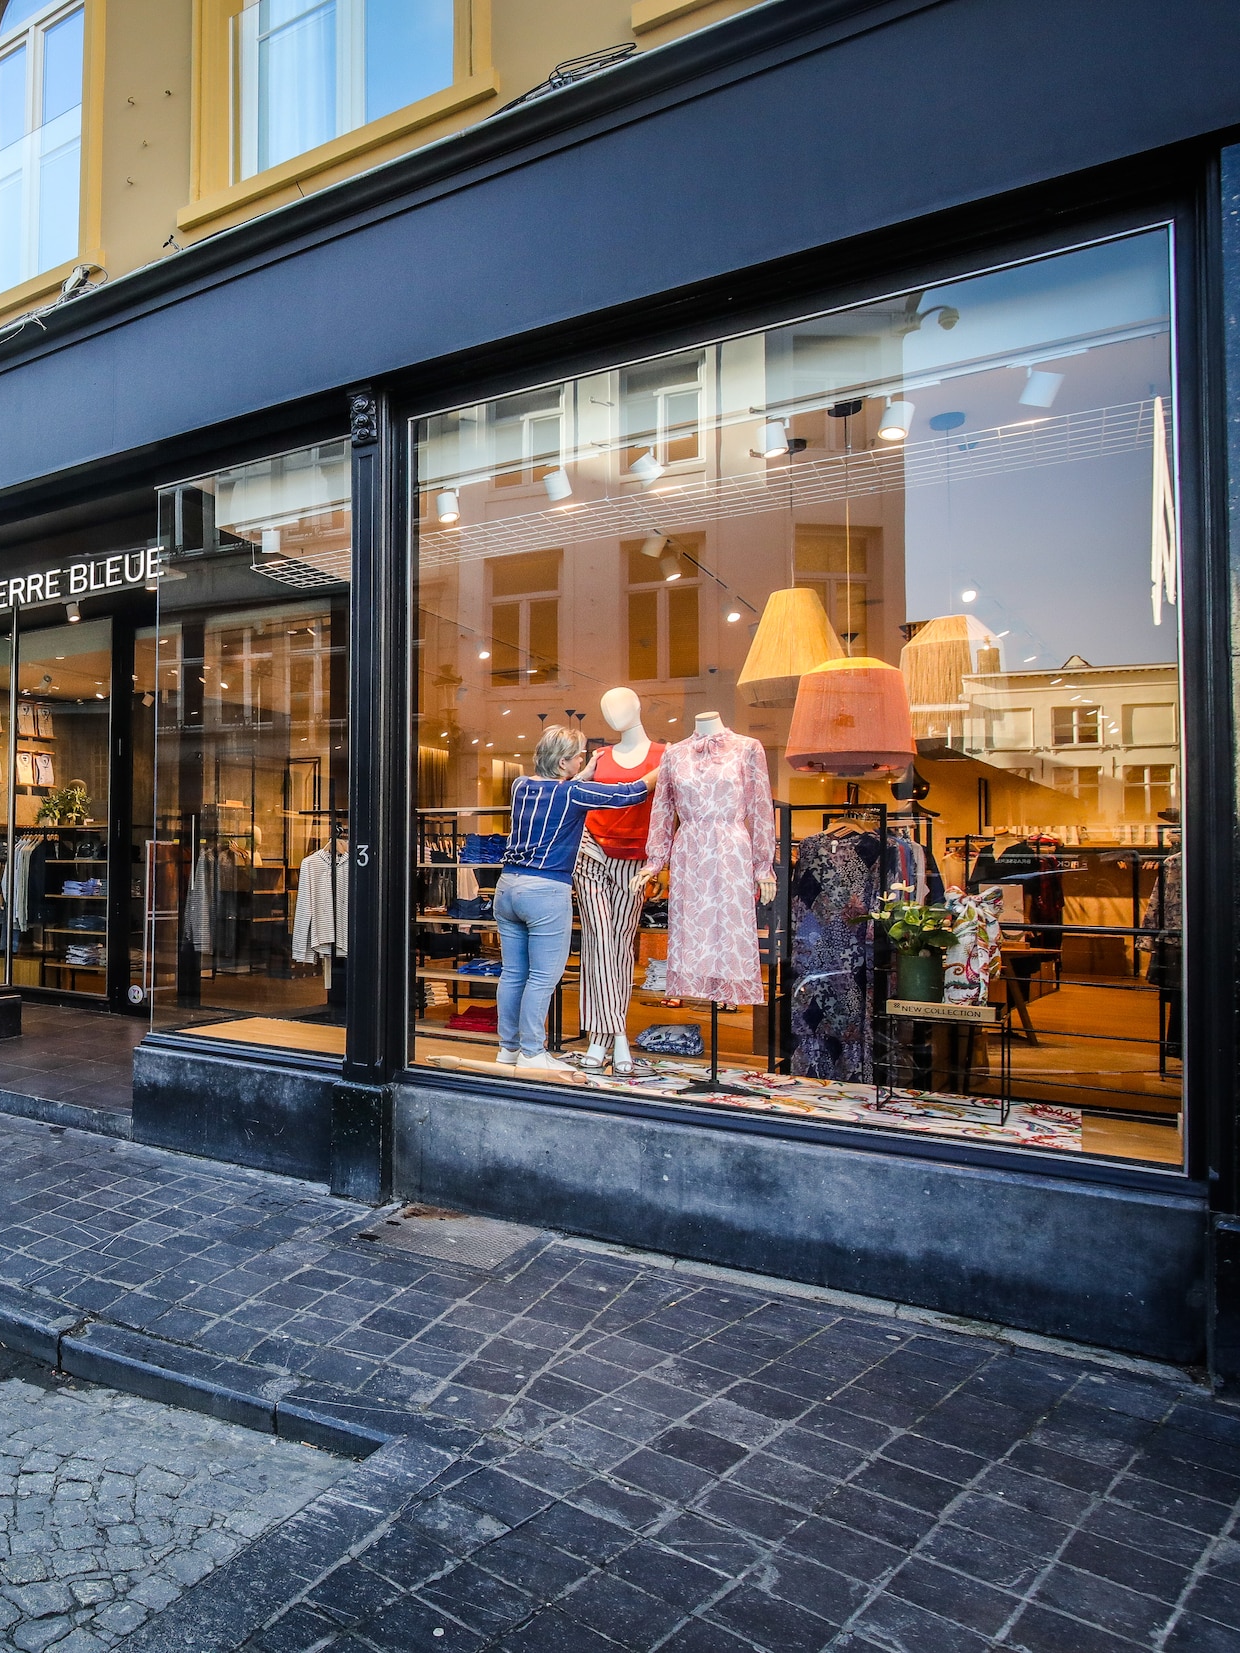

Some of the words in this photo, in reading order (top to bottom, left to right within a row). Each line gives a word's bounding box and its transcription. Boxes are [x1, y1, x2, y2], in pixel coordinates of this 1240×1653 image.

[69, 546, 166, 595] BLEUE
[356, 843, 370, 867] 3
[901, 1005, 922, 1013] NEW
[924, 1008, 981, 1018] COLLECTION
